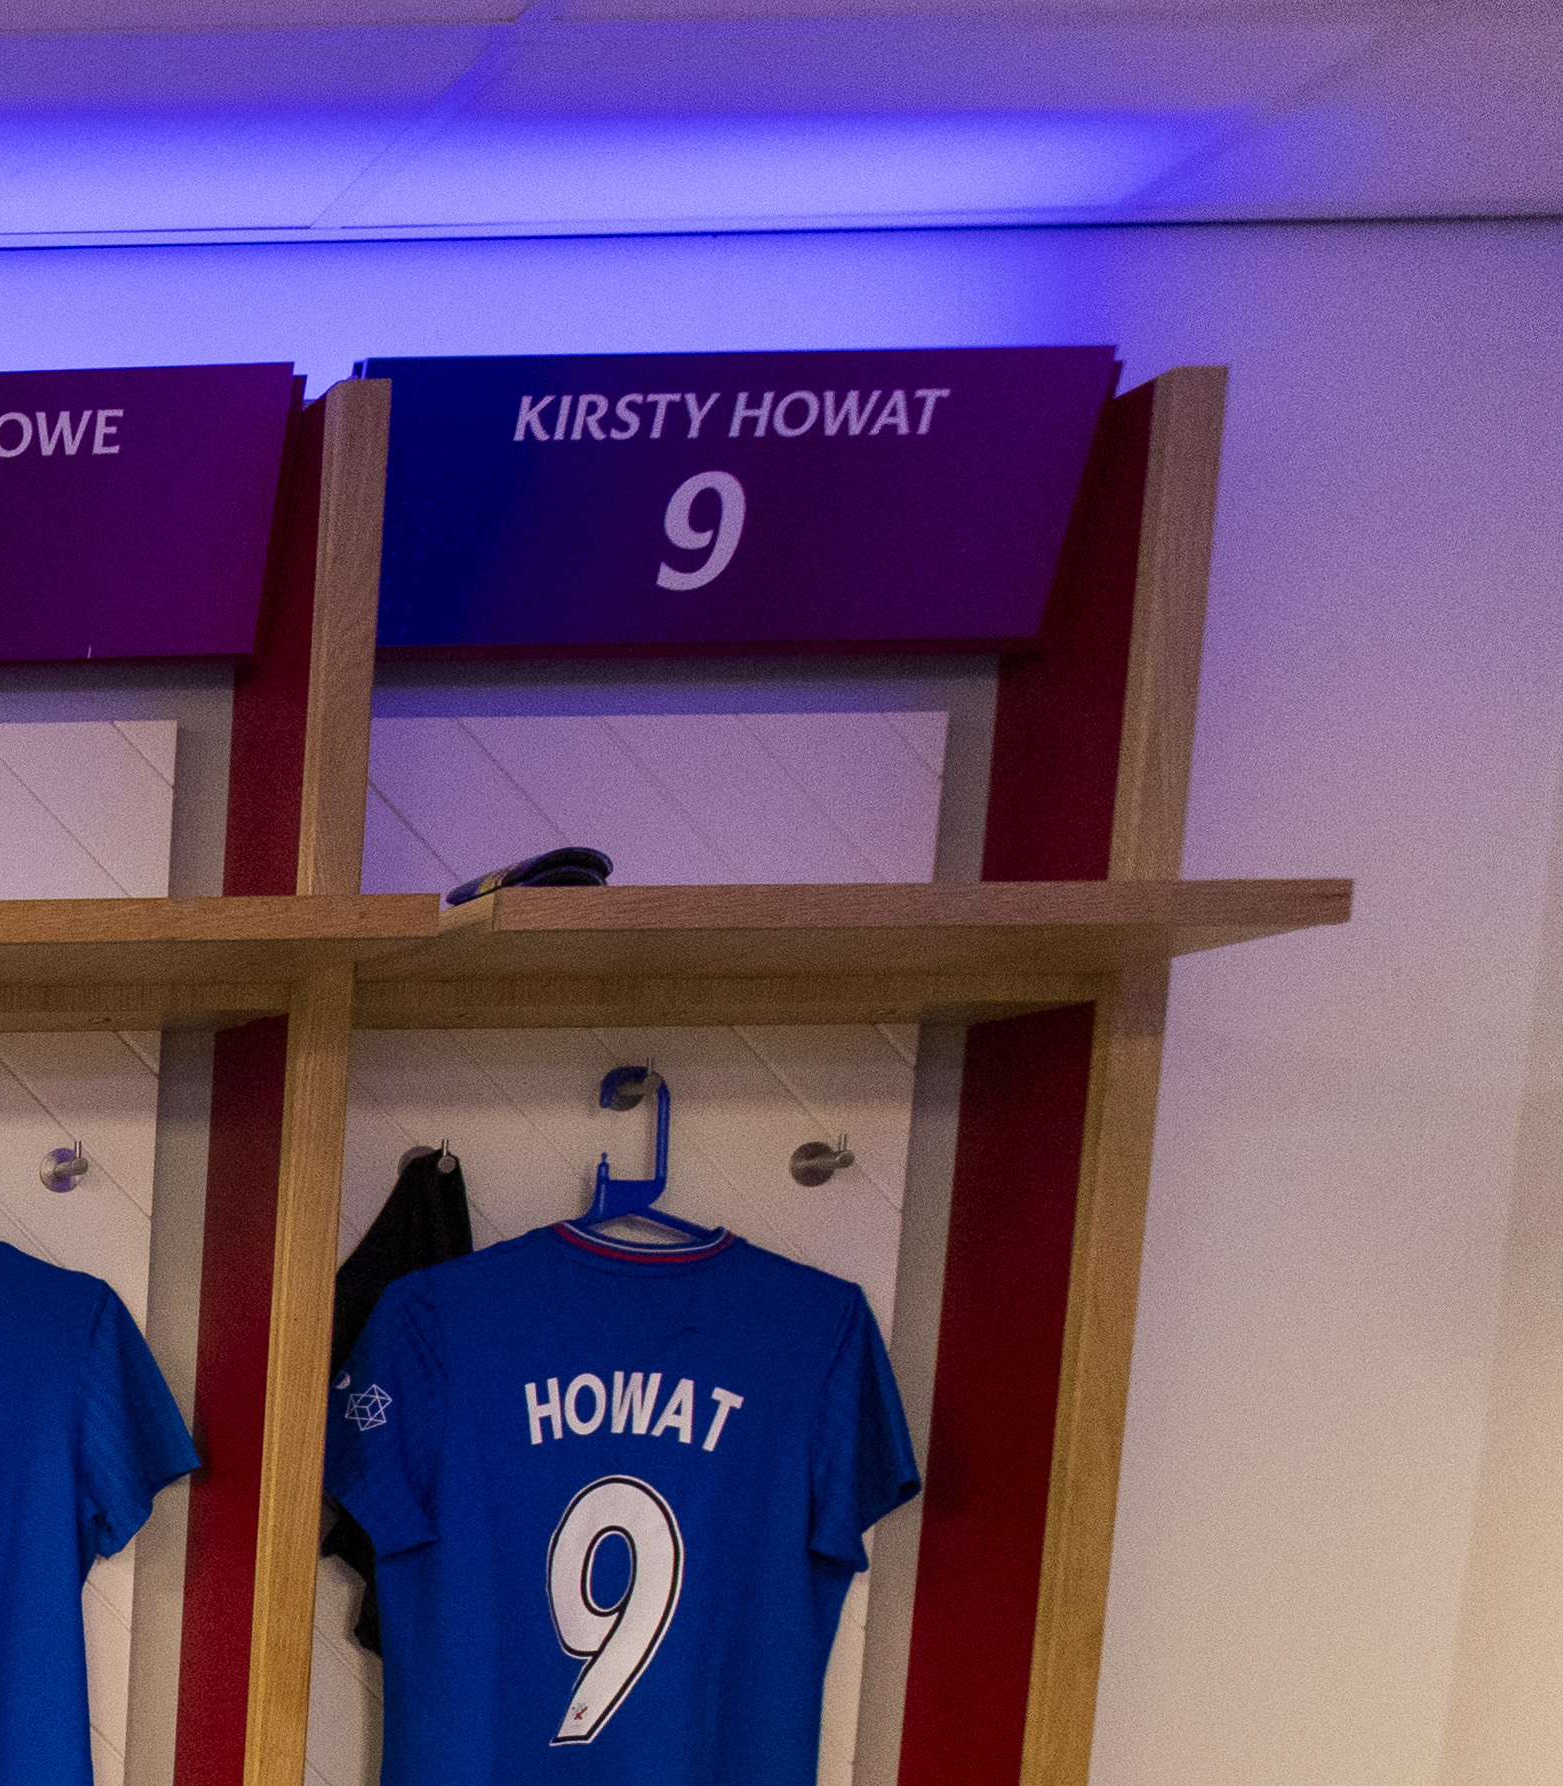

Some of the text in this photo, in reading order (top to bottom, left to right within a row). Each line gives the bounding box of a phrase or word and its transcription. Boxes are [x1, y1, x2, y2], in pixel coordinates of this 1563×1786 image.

[512, 387, 952, 442] KIRSTY HOWAT
[655, 470, 747, 592] 9
[524, 1370, 745, 1452] HOWAT
[546, 1473, 686, 1748] 9
